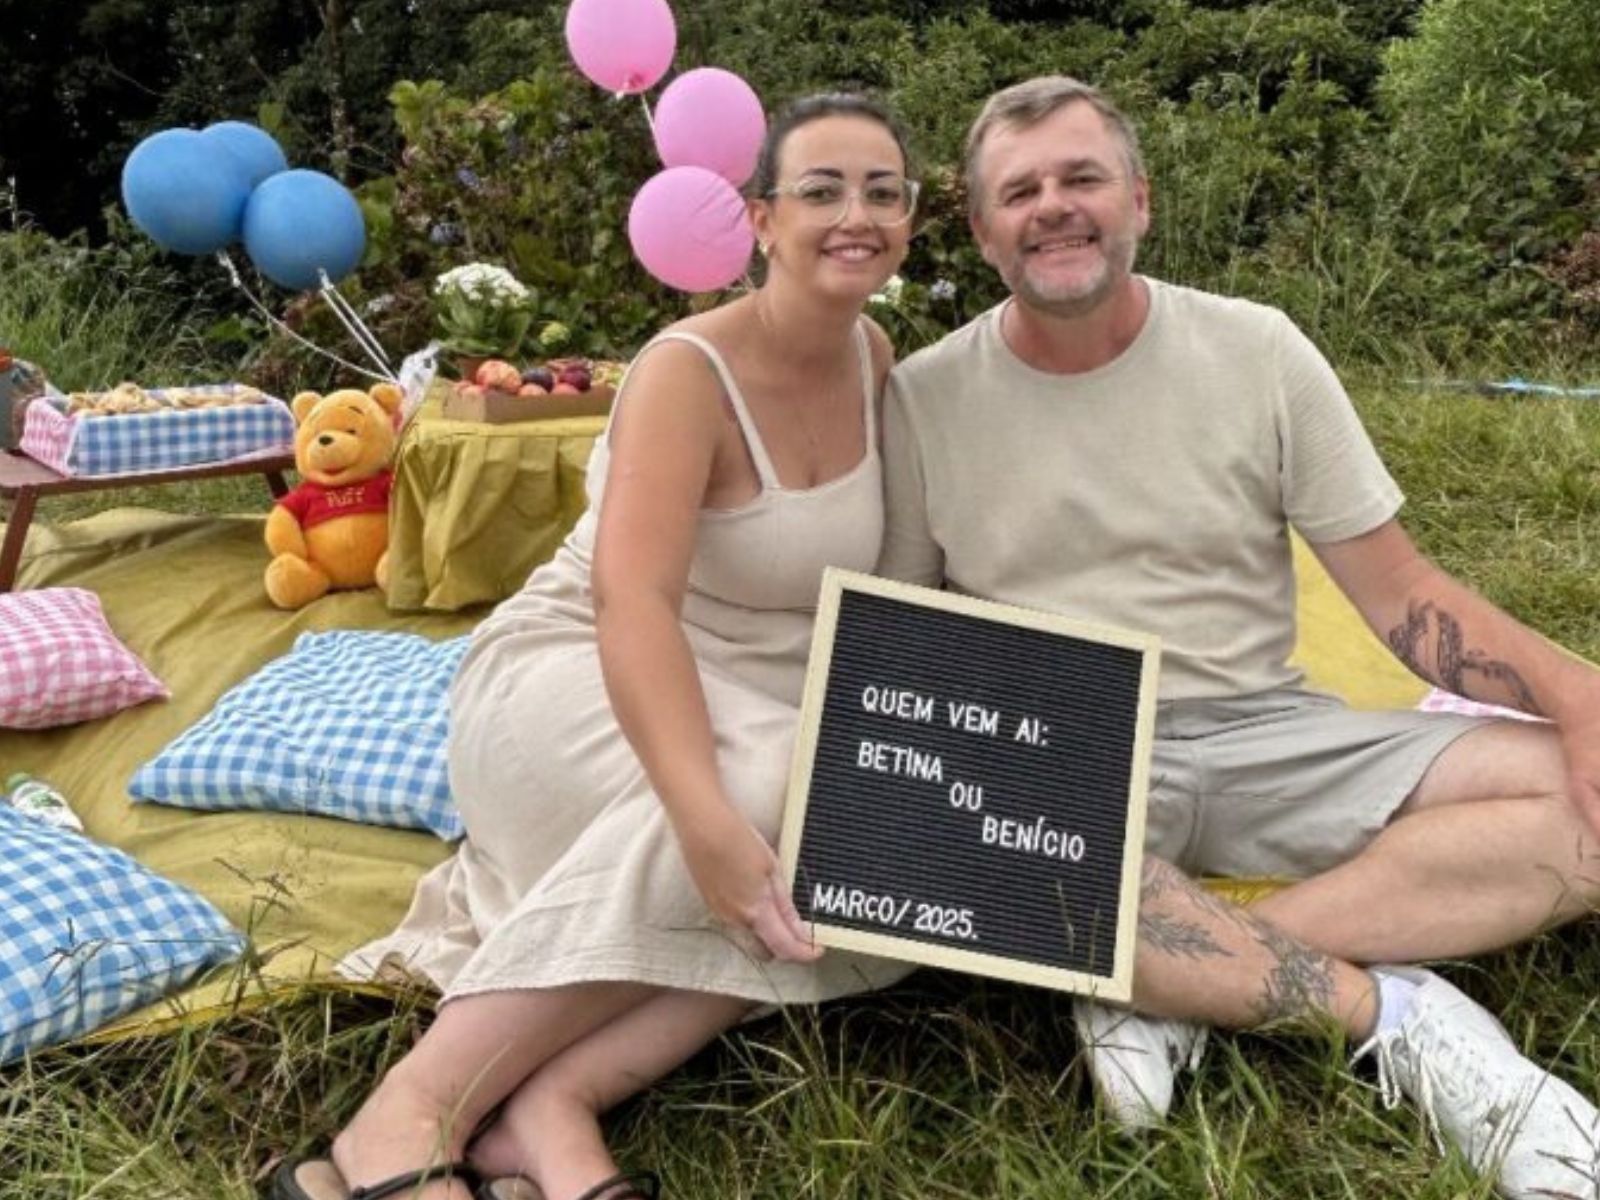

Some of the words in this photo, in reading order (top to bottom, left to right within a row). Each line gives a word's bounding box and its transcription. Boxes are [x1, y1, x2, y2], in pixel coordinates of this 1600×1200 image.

[862, 685, 935, 722] QUEM
[947, 701, 1000, 736] VEM
[1014, 717, 1049, 746] AI:
[857, 741, 943, 783] BETINA
[949, 781, 983, 812] OU
[982, 815, 1086, 862] BENÍCIO
